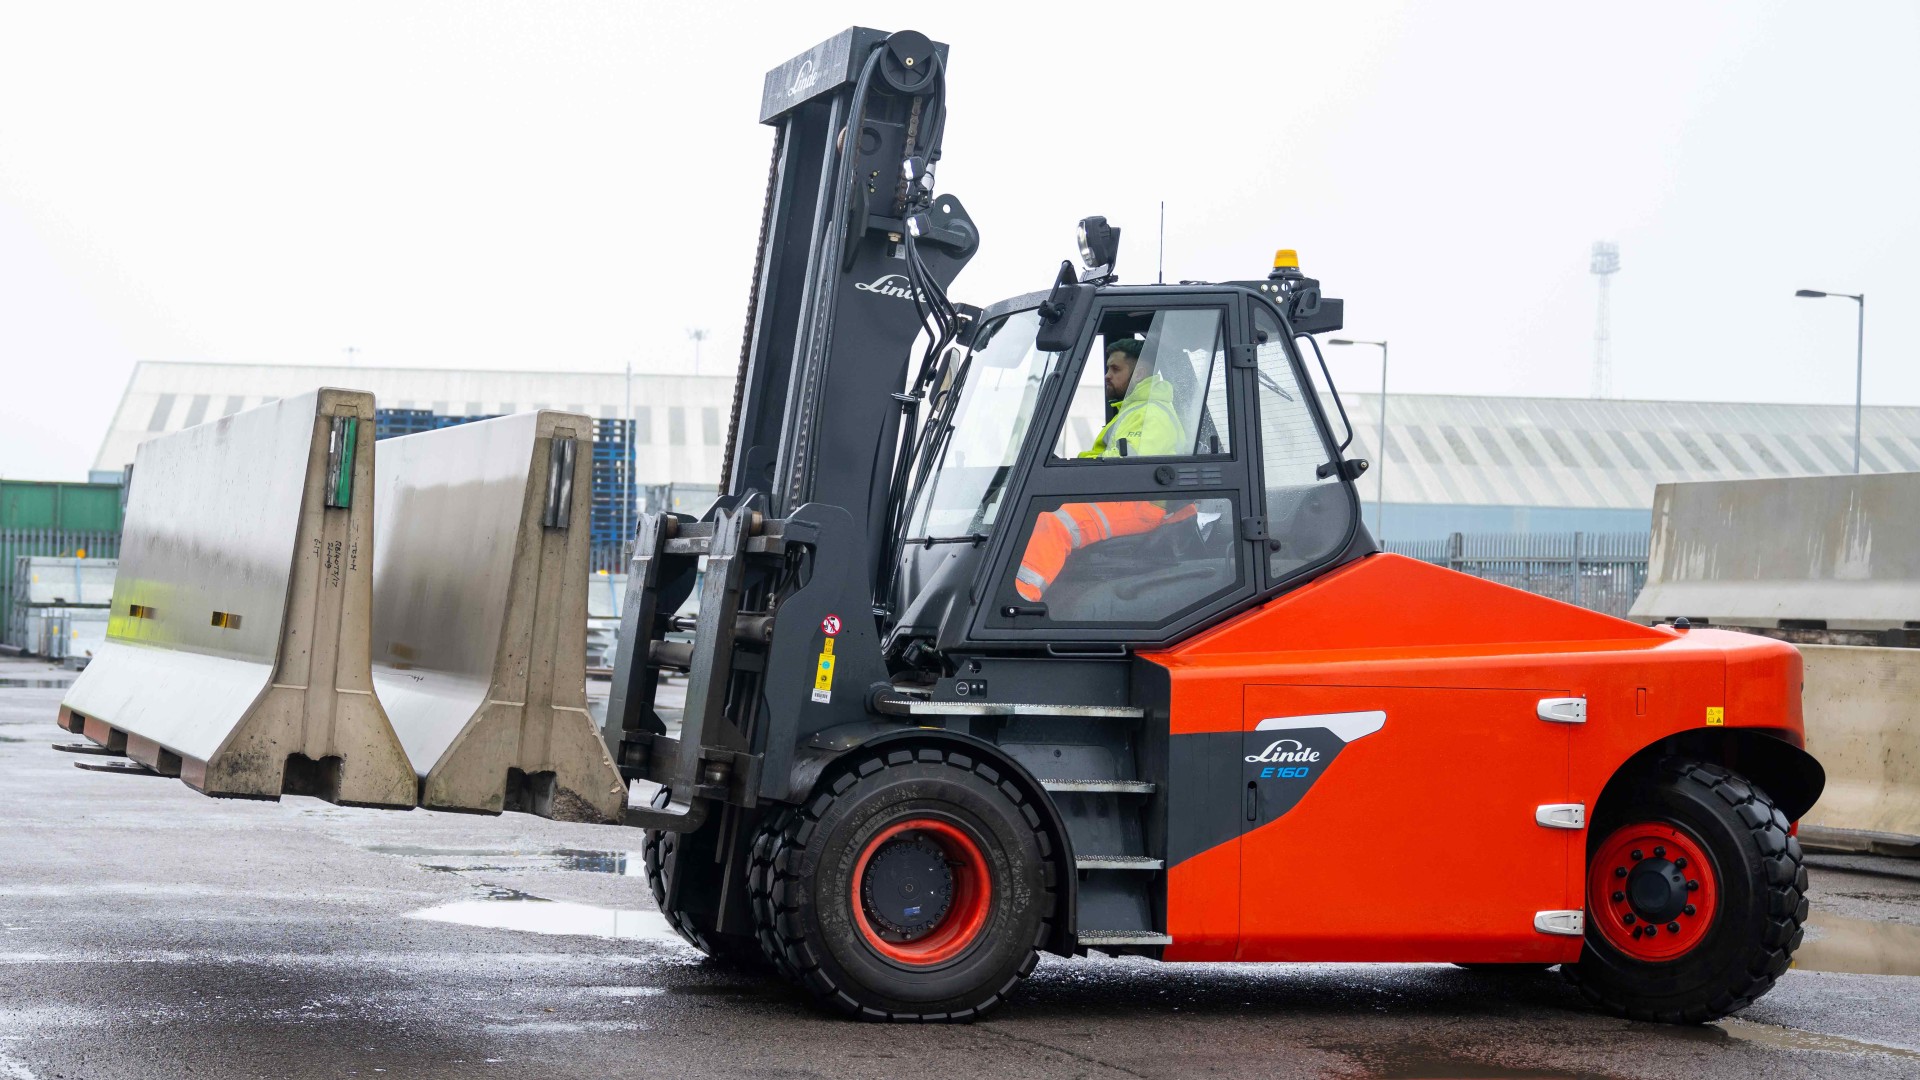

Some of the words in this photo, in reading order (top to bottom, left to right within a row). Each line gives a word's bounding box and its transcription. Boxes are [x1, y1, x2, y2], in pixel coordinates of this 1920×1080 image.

[787, 60, 818, 97] Linde
[1244, 739, 1320, 763] Linde
[1260, 767, 1275, 778] E
[1276, 767, 1309, 778] 160
